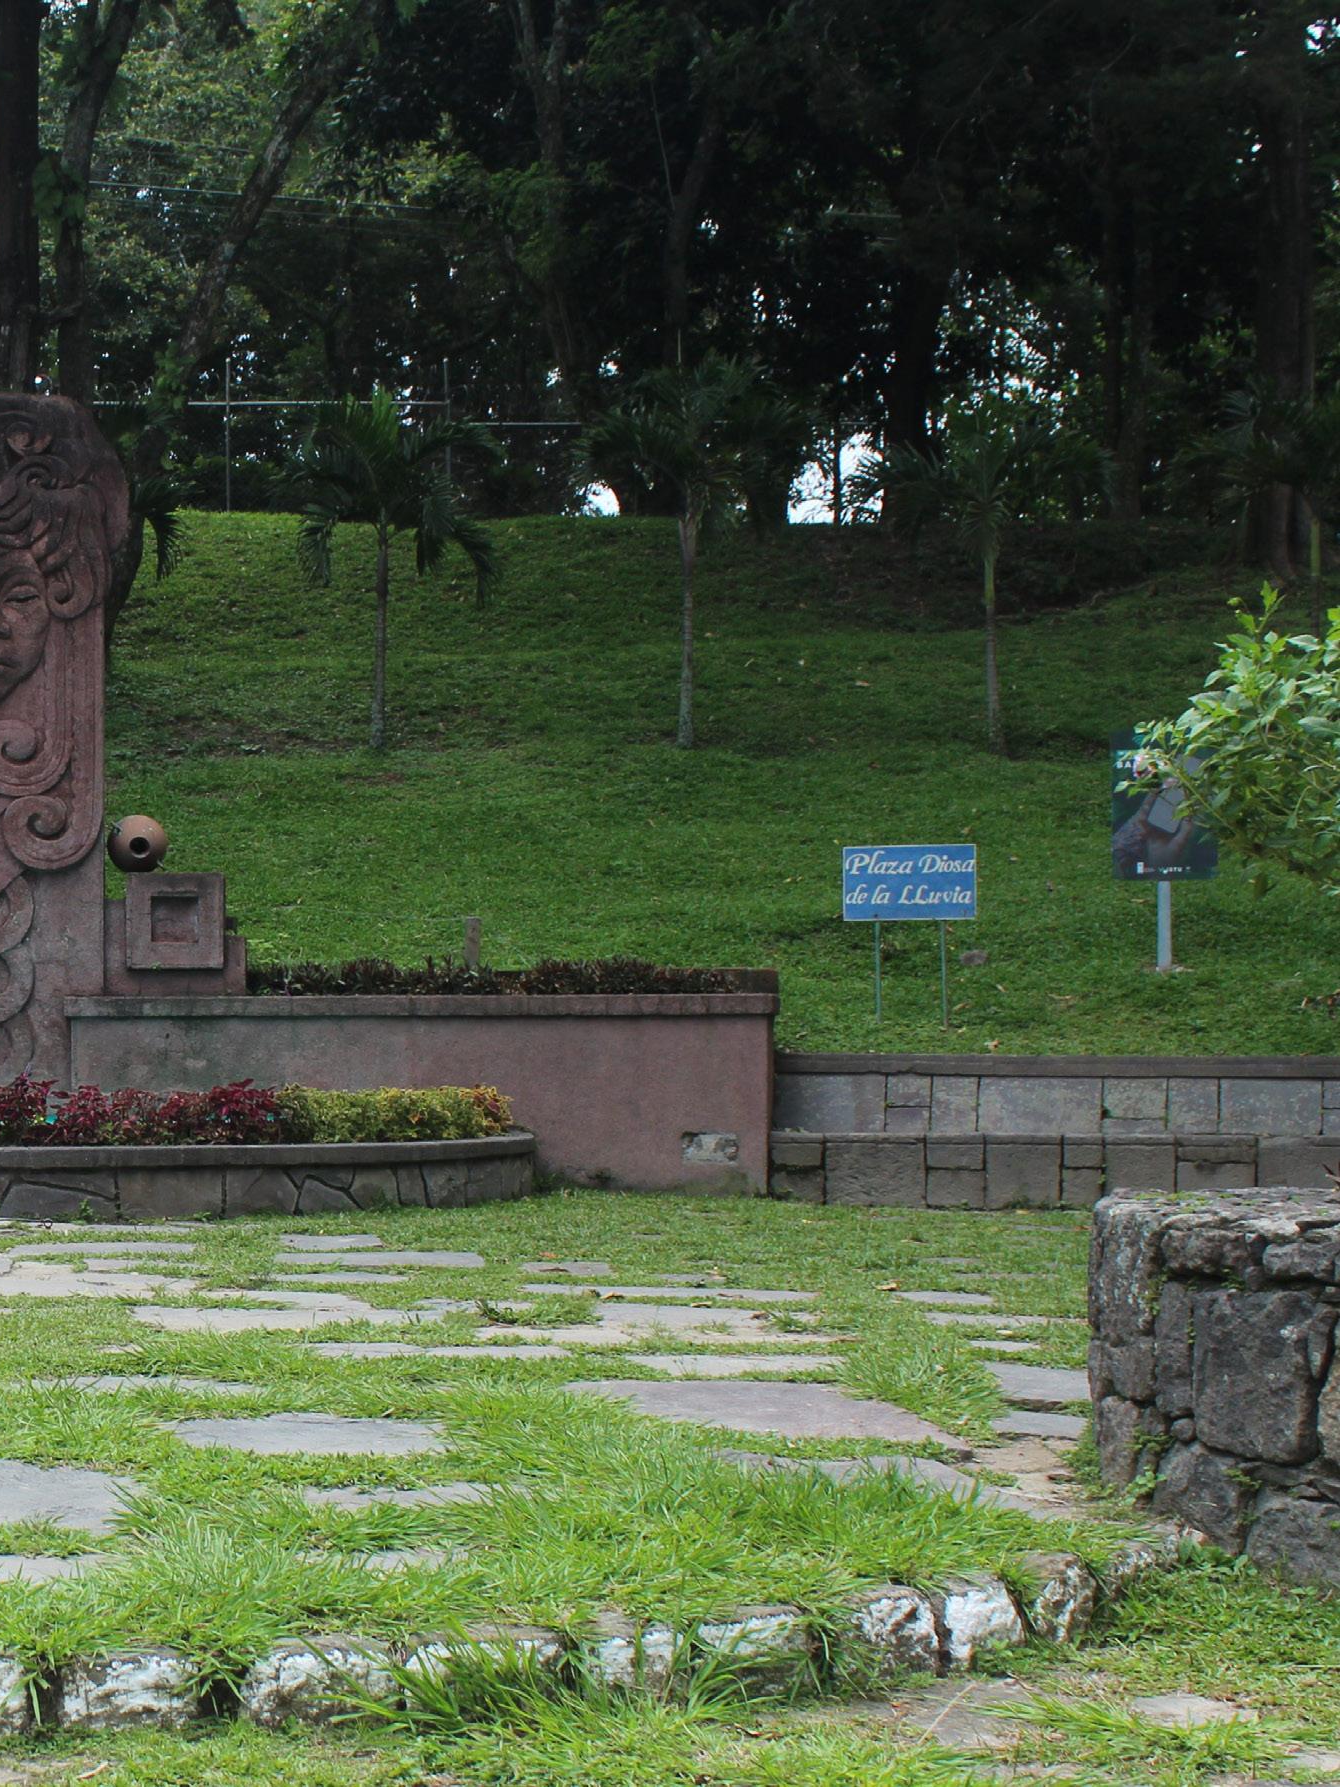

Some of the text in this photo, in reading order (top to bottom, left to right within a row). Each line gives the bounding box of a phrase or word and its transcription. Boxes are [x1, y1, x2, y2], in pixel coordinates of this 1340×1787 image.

[846, 850, 976, 874] Plaza Diosa
[846, 884, 972, 905] de la LLuvia
